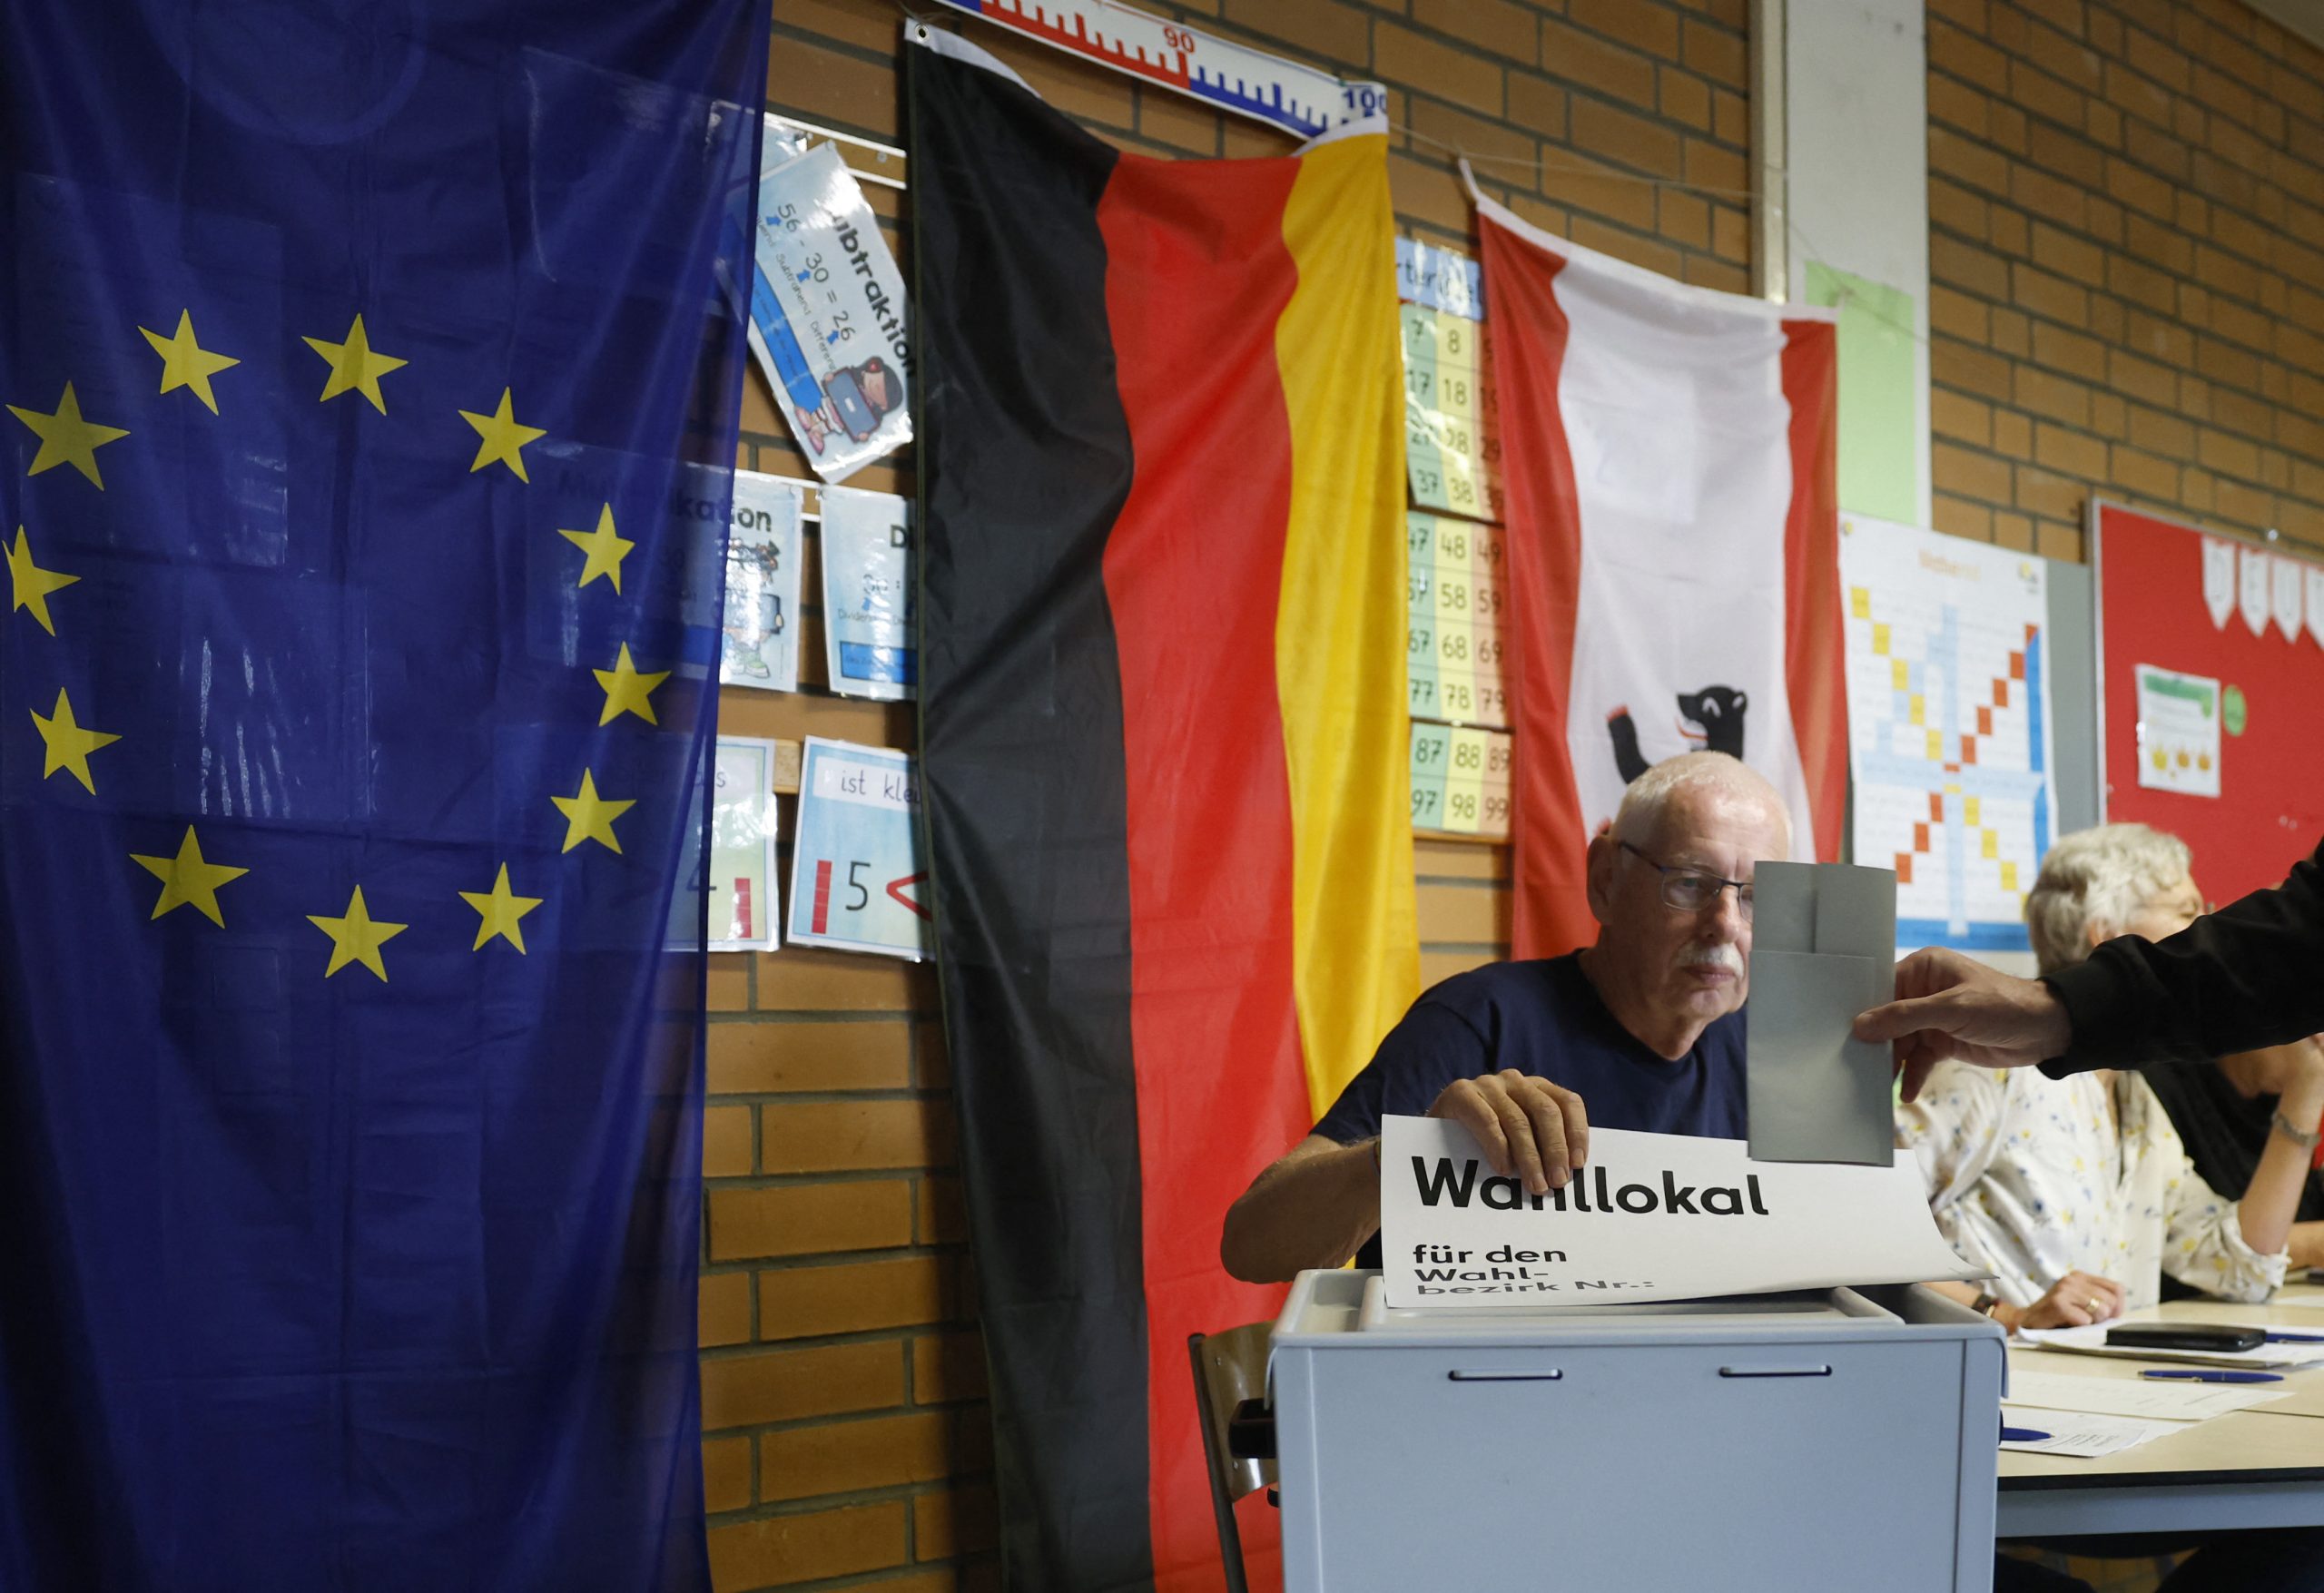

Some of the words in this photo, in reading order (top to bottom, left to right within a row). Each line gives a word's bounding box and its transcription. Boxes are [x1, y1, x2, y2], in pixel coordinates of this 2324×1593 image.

[1164, 26, 1196, 54] 90
[778, 203, 802, 232] 56
[806, 252, 829, 283] 30
[832, 310, 856, 341] 26
[824, 208, 915, 379] ubtraktion
[1448, 329, 1461, 355] 8
[1444, 379, 1467, 406] 18
[1441, 533, 1467, 560] 48
[1441, 584, 1468, 609] 58
[1442, 635, 1468, 660] 68
[1410, 679, 1433, 704] 77
[1444, 684, 1471, 710] 78
[1415, 738, 1443, 764] 87
[1454, 742, 1481, 769] 88
[1489, 747, 1511, 772] 89
[841, 770, 867, 795] ist
[1412, 790, 1438, 817] 97
[1452, 793, 1477, 820] 98
[1485, 797, 1509, 821] 99
[845, 860, 872, 911] 5
[1413, 1244, 1473, 1264] für
[1485, 1244, 1568, 1263] den
[1414, 1267, 1549, 1282] Wahl-
[1416, 1283, 1561, 1295] bezirk
